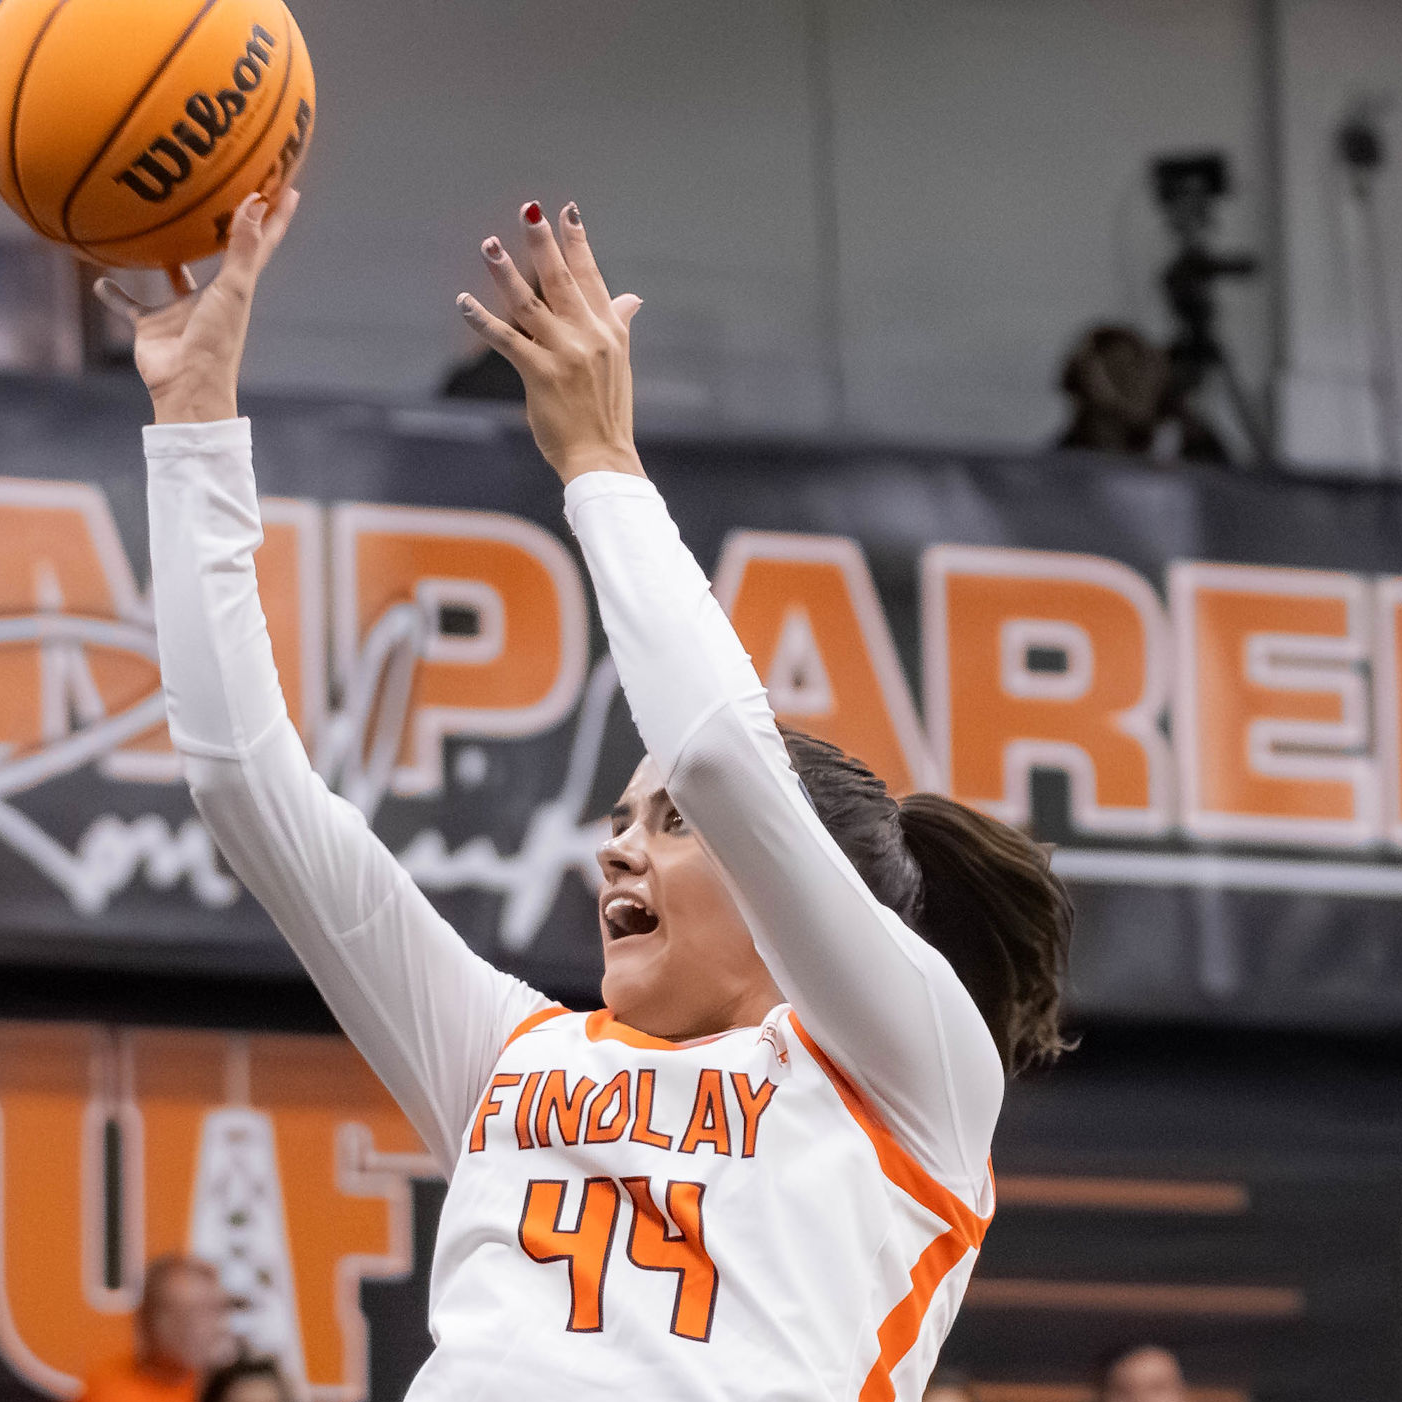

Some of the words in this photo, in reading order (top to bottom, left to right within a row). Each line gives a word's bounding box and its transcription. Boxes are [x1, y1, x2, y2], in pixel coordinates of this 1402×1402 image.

[113, 23, 277, 203] Wilson
[469, 1068, 779, 1159] FINDLAY
[517, 1175, 720, 1344] 44
